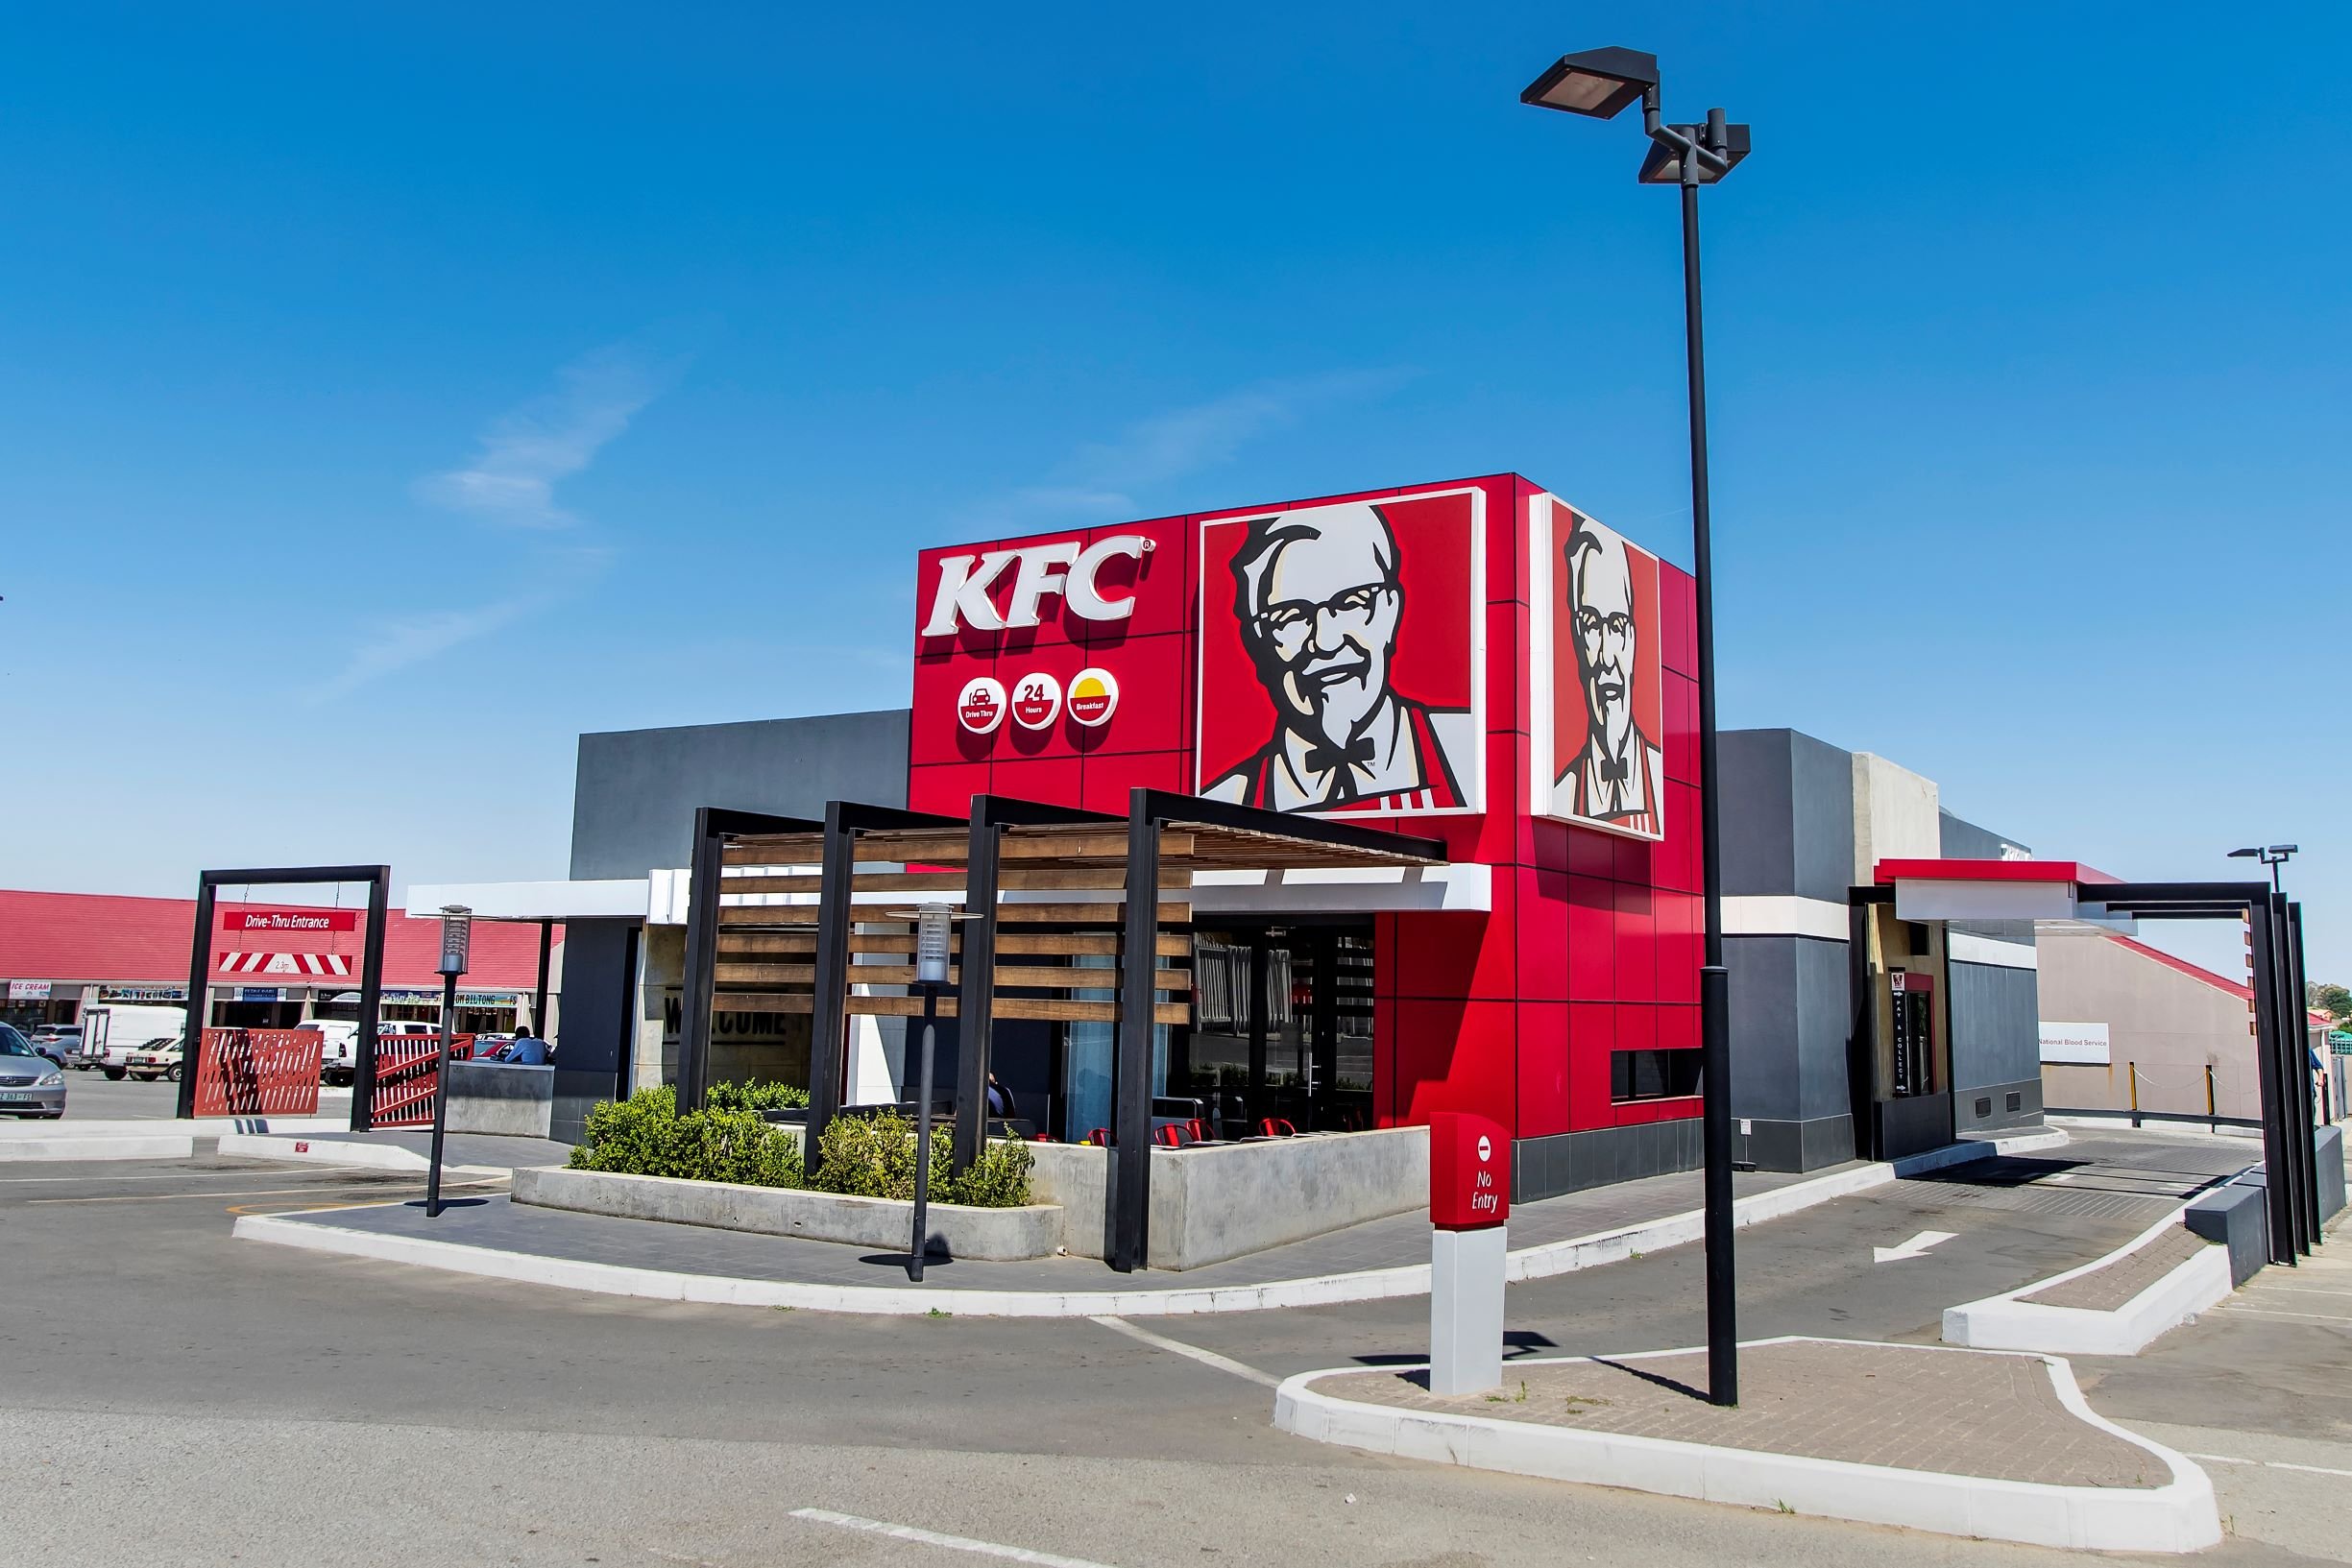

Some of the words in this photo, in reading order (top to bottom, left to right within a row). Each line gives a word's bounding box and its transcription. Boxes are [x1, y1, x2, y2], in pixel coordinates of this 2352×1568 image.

[921, 535, 1146, 637] KFC
[1024, 684, 1044, 701] 24
[965, 711, 981, 719] Drive
[981, 710, 993, 718] Thru
[1025, 706, 1042, 714] Hours
[1076, 701, 1104, 712] Breakfast
[245, 914, 290, 928] Drive-Thru
[291, 915, 329, 929] Entrance
[465, 994, 496, 1005] BILTONG
[664, 997, 786, 1035] WCOME
[1477, 1170, 1492, 1188] No
[1471, 1191, 1498, 1214] Entry
